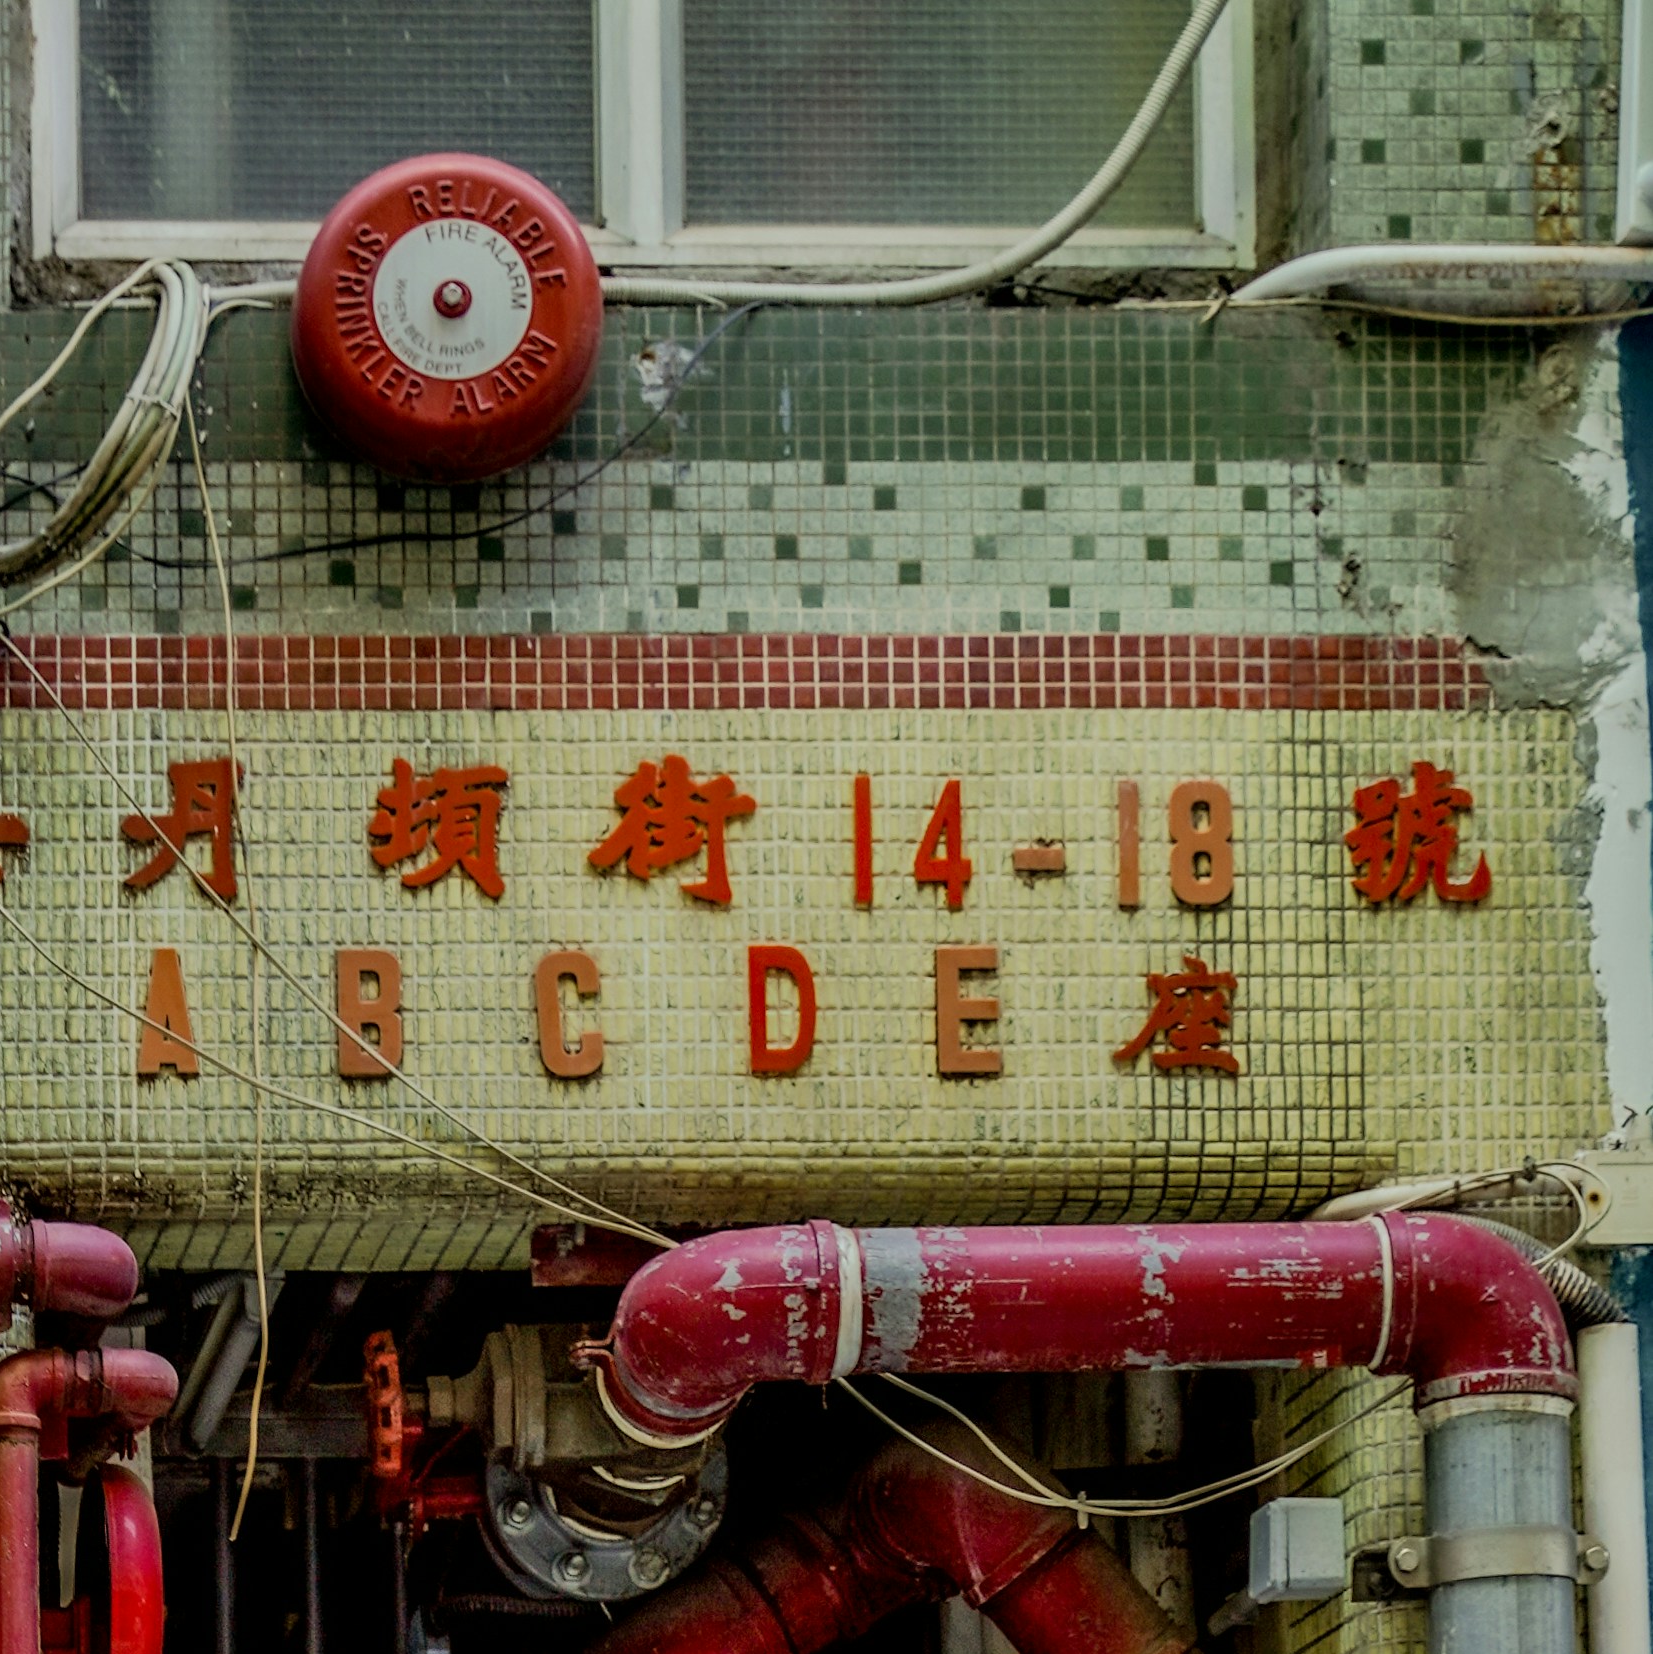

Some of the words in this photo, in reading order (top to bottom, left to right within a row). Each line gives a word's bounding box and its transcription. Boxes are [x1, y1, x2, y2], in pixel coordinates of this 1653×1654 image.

[407, 180, 568, 292] RELIABLE
[425, 221, 479, 243] FIRE
[482, 236, 529, 311] ALARM
[335, 223, 425, 411] SPRINKLER
[449, 329, 558, 416] ALARM
[377, 302, 396, 341] CALL
[392, 338, 421, 365] FIRE
[395, 277, 408, 323] WHEN
[404, 324, 434, 352] BELL
[439, 337, 486, 358] RINGS
[853, 773, 1235, 910] 14-18
[1344, 761, 1493, 903] 號
[140, 947, 200, 1078] A
[337, 949, 404, 1078] B
[535, 949, 604, 1078] C
[749, 945, 816, 1074] D
[936, 945, 1002, 1073] E
[1113, 956, 1240, 1075] 座
